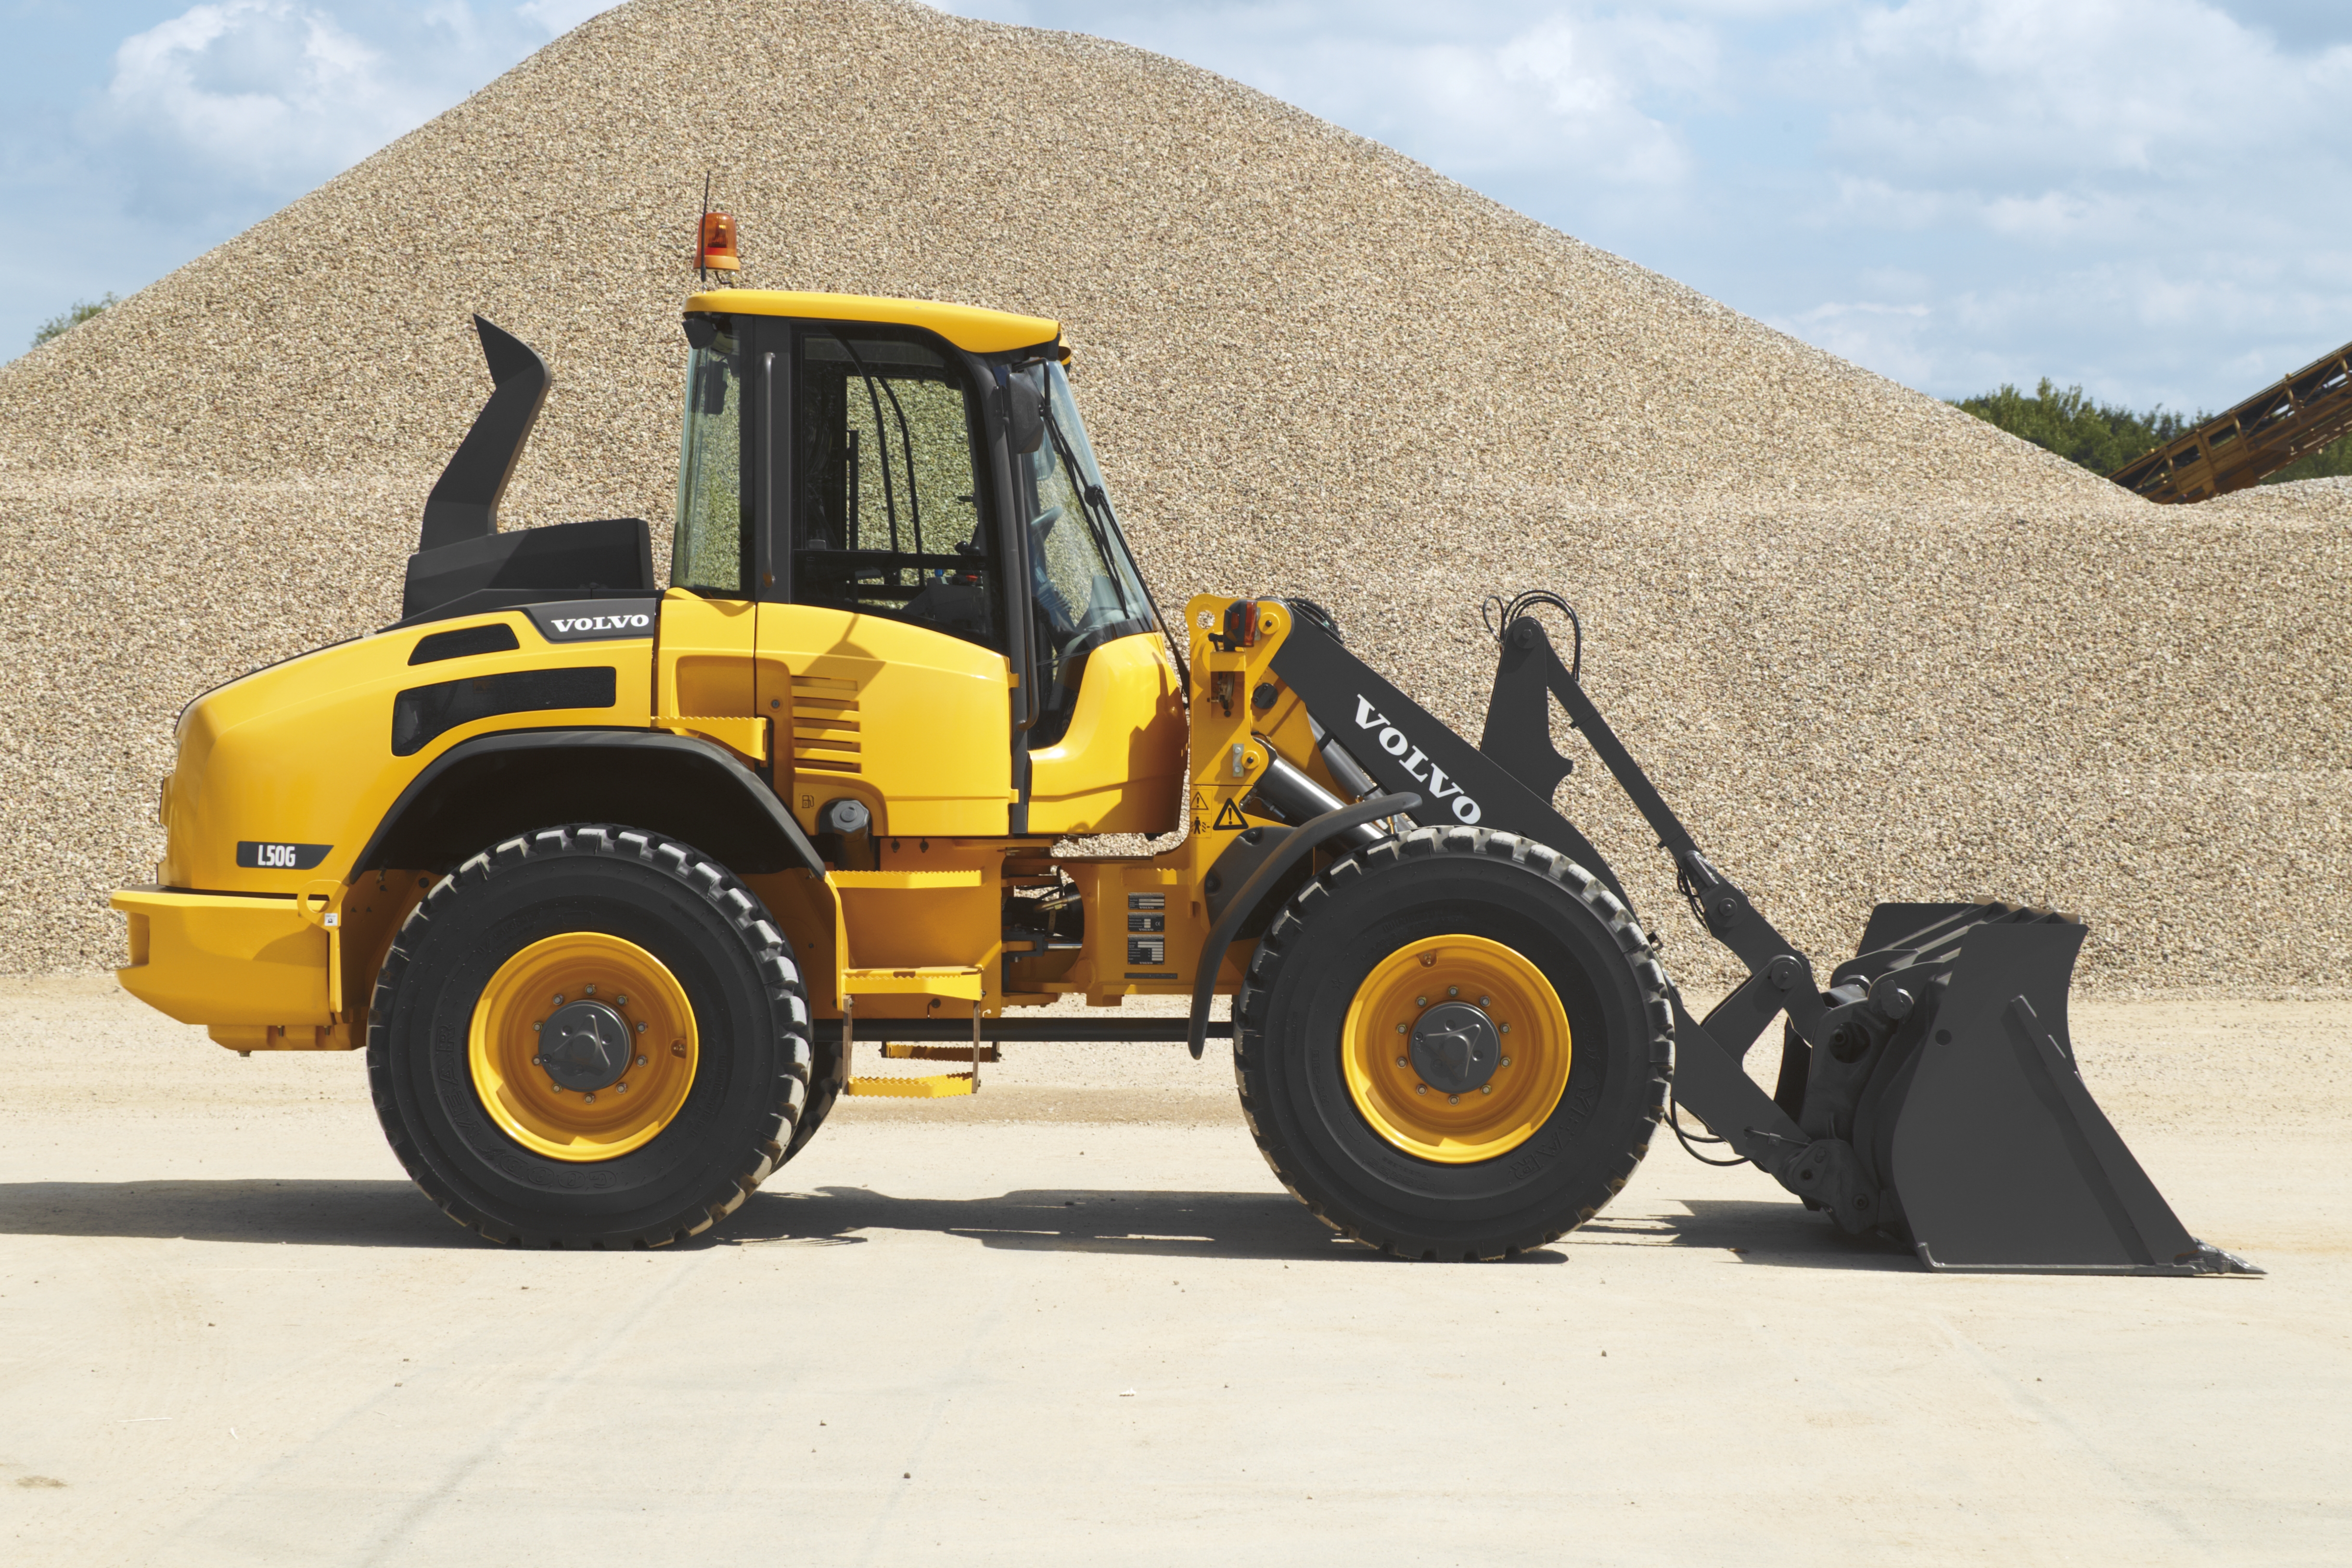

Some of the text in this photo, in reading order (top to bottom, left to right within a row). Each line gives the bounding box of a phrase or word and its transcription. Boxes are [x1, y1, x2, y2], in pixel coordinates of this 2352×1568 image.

[550, 614, 649, 632] VOLVO
[1355, 693, 1481, 825] VOLVO
[257, 844, 296, 867] L50G
[435, 1023, 618, 1190] GOODYEAR
